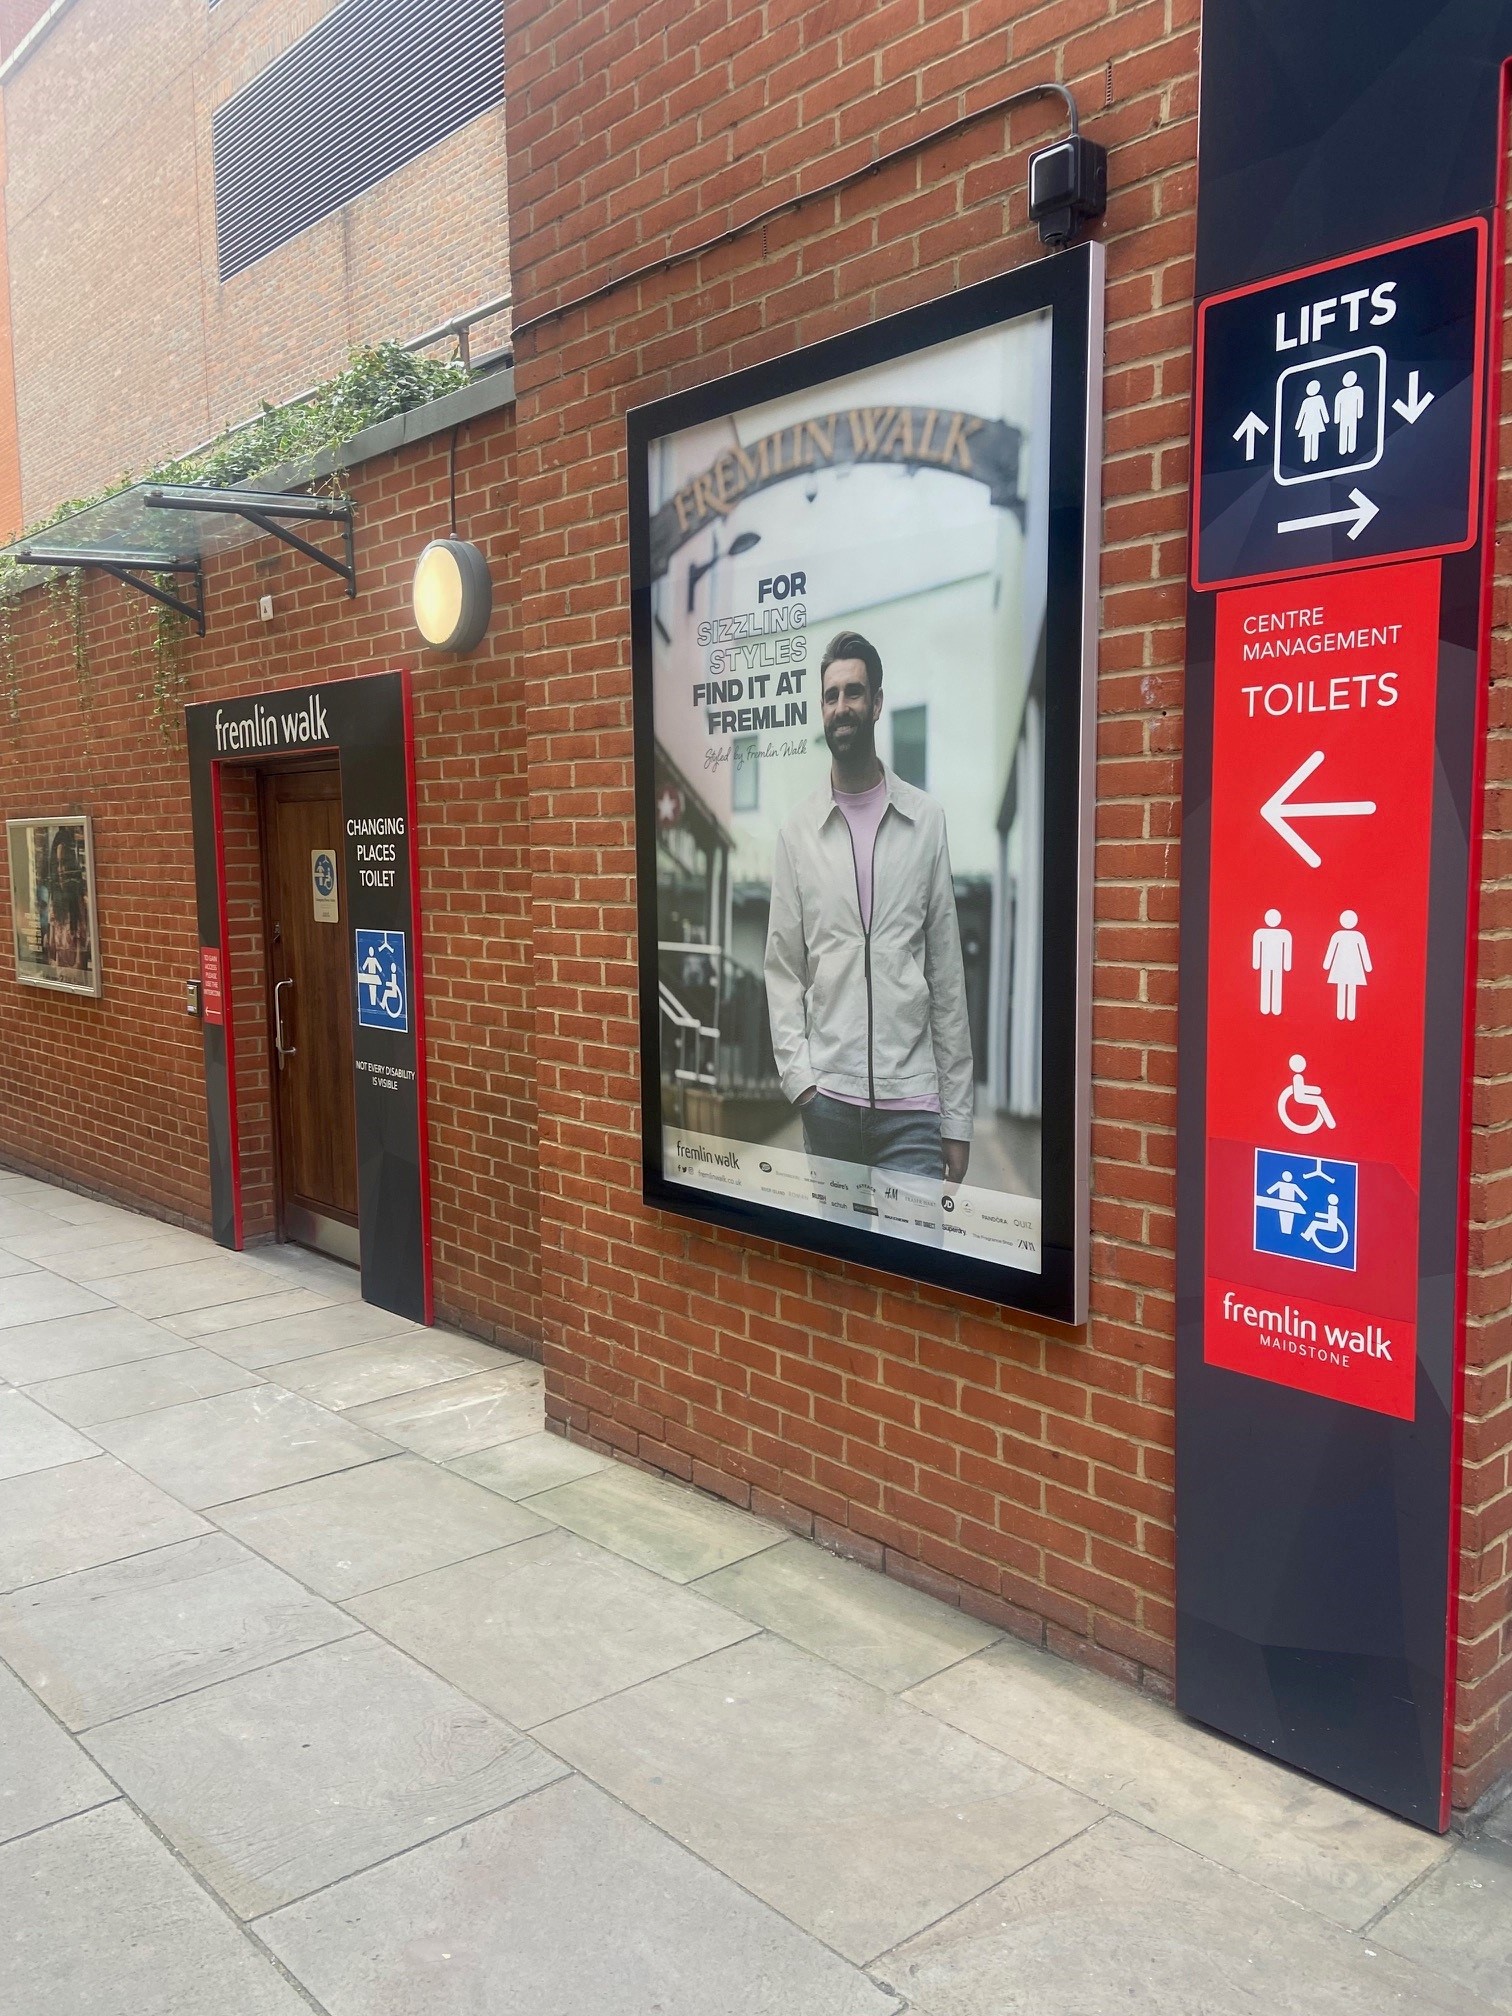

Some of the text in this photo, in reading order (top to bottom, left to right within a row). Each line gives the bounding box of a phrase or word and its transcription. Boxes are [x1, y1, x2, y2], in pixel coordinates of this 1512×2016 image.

[1275, 281, 1397, 352] LIFTS
[673, 405, 986, 531] FREMLIN WALK
[758, 571, 807, 603] FOR
[697, 603, 807, 646] SIZZLING
[1243, 606, 1324, 635] CENTRE
[710, 636, 807, 675] STYLES
[1242, 624, 1402, 661] MANAGEMENT
[693, 669, 807, 706] FIND IT AT
[1241, 672, 1399, 718] TOILETS
[215, 693, 330, 751] fremlin walk
[708, 701, 807, 735] FREMLIN
[704, 739, 808, 773] Styled by Fremlin Walk
[347, 817, 405, 836] CHANGING
[357, 844, 396, 861] PLACES
[359, 870, 395, 887] TOILET
[355, 1060, 416, 1081] NOT EVERY DISABILITY
[372, 1076, 398, 1091] IS VISIBLE
[677, 1140, 713, 1163] fremlin
[714, 1152, 740, 1170] walk
[829, 1180, 849, 1190] claire's
[831, 1201, 848, 1210] schuh
[981, 1214, 1009, 1225] PANDORA
[941, 1223, 967, 1237] Superdry
[1013, 1218, 1033, 1230] QUIZ
[1223, 1292, 1393, 1362] fremlin walk
[1260, 1334, 1350, 1368] MAIDSTONE
